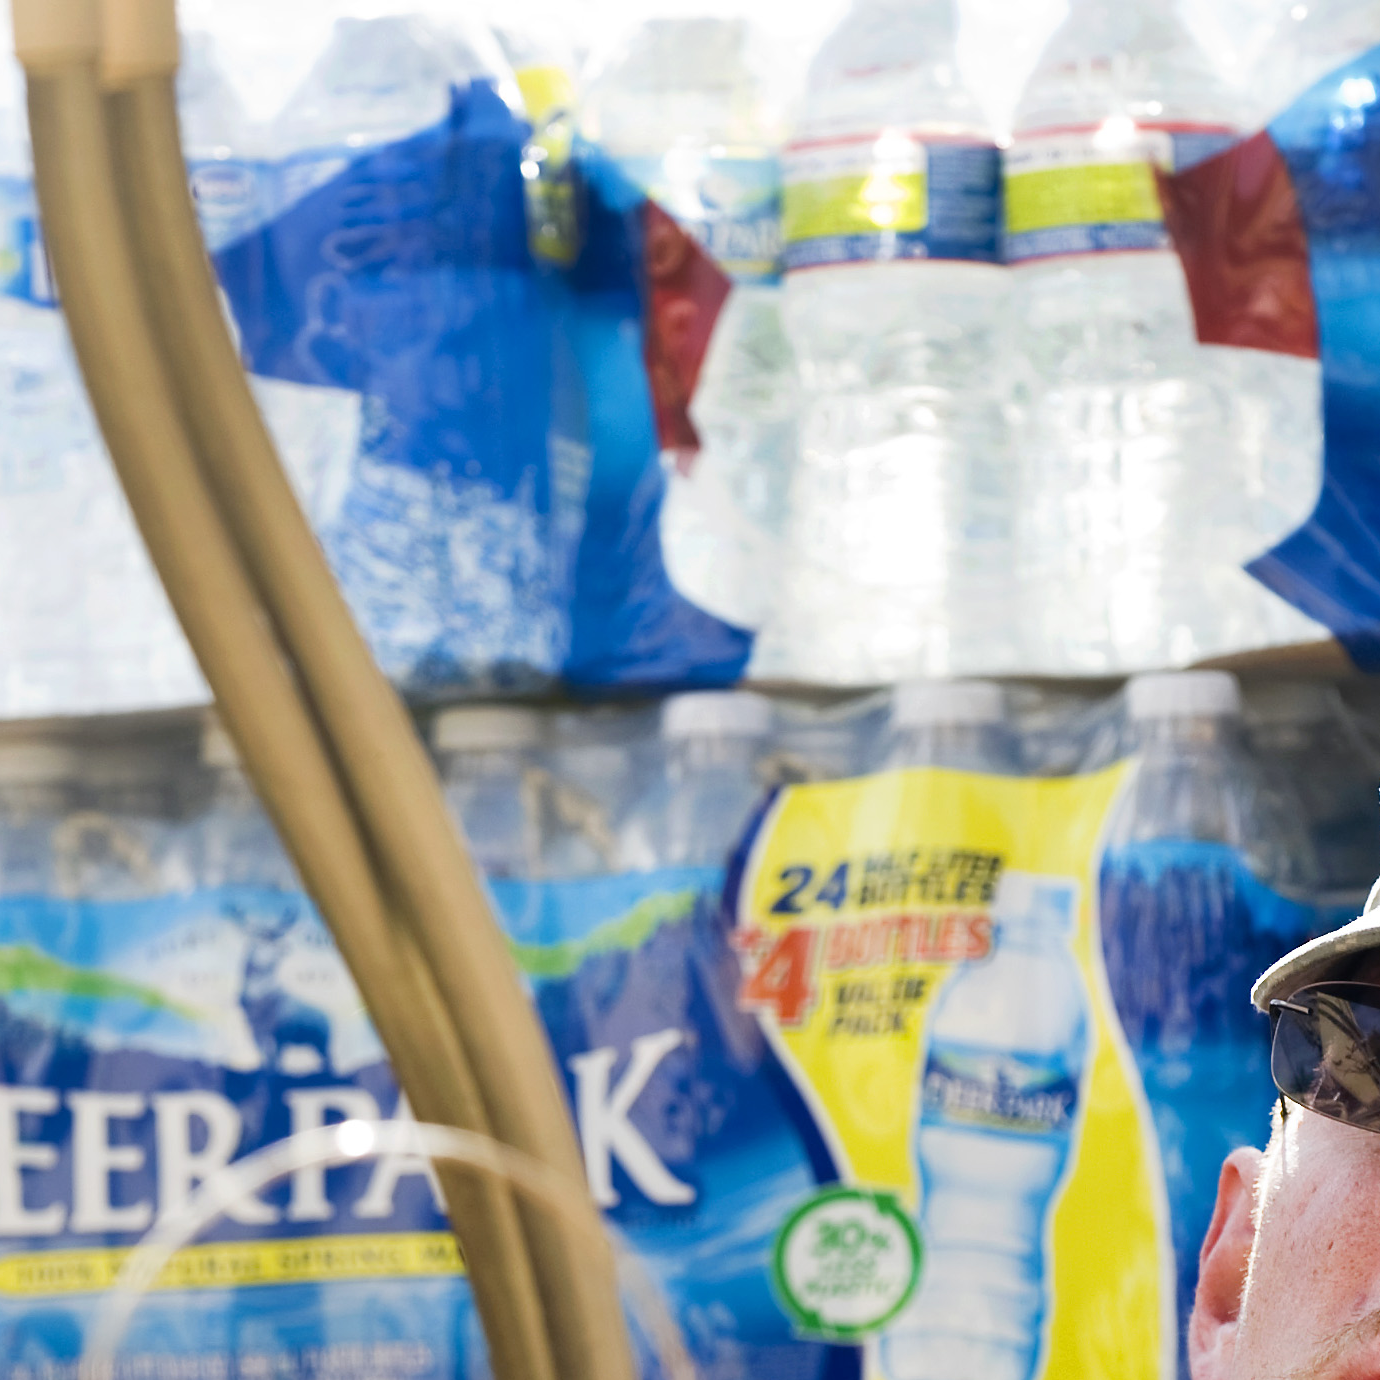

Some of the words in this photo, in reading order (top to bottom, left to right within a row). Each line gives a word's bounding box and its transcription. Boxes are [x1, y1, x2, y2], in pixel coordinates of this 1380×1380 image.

[770, 862, 850, 914] 24
[825, 911, 994, 970] BOTTLES
[283, 1027, 697, 1224] PAK
